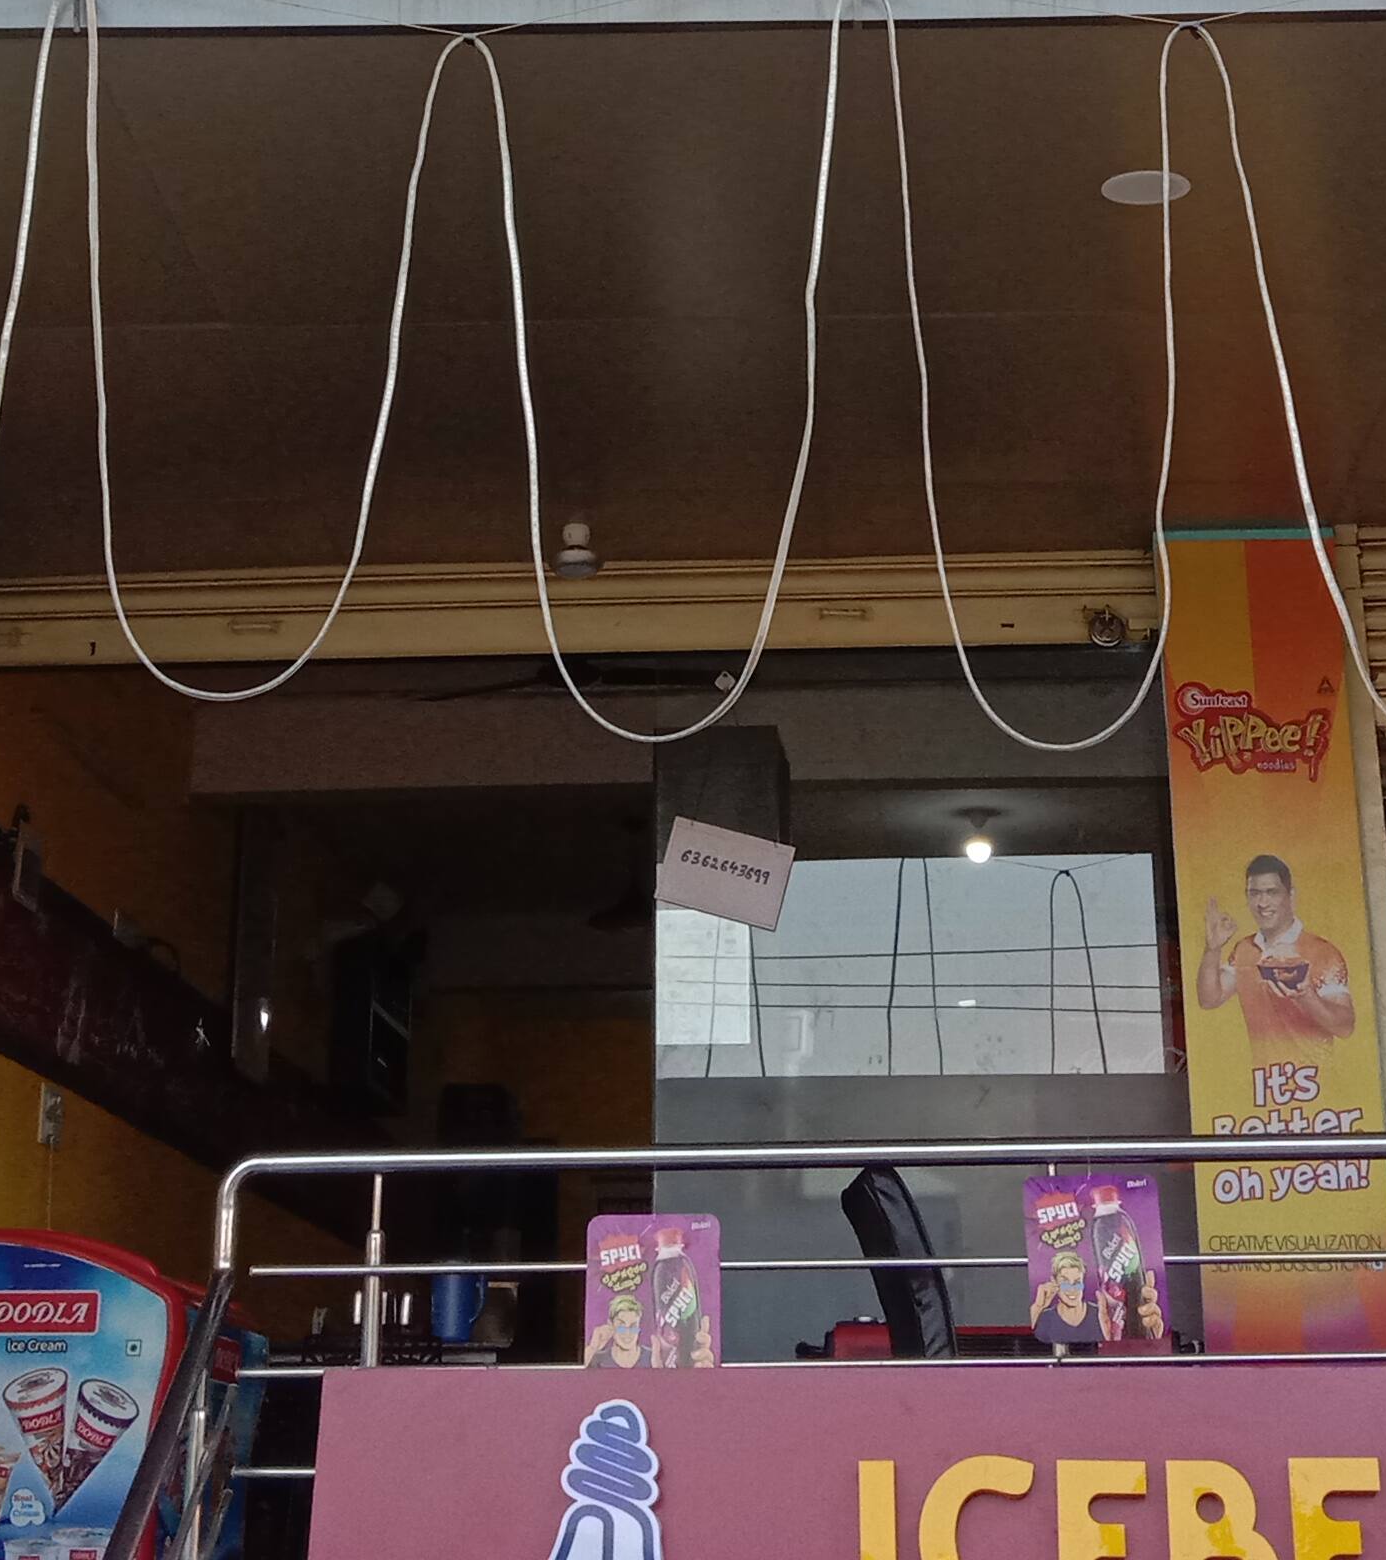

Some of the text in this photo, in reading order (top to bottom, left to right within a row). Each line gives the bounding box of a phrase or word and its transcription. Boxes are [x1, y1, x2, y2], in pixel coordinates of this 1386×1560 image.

[1190, 692, 1248, 708] Sunfeast
[1252, 1062, 1319, 1107] It's
[1269, 1159, 1370, 1202] yeah!
[1037, 1201, 1081, 1225] SPYCI
[599, 1244, 642, 1266] SPYCI
[7, 1339, 67, 1352] Ice Cream
